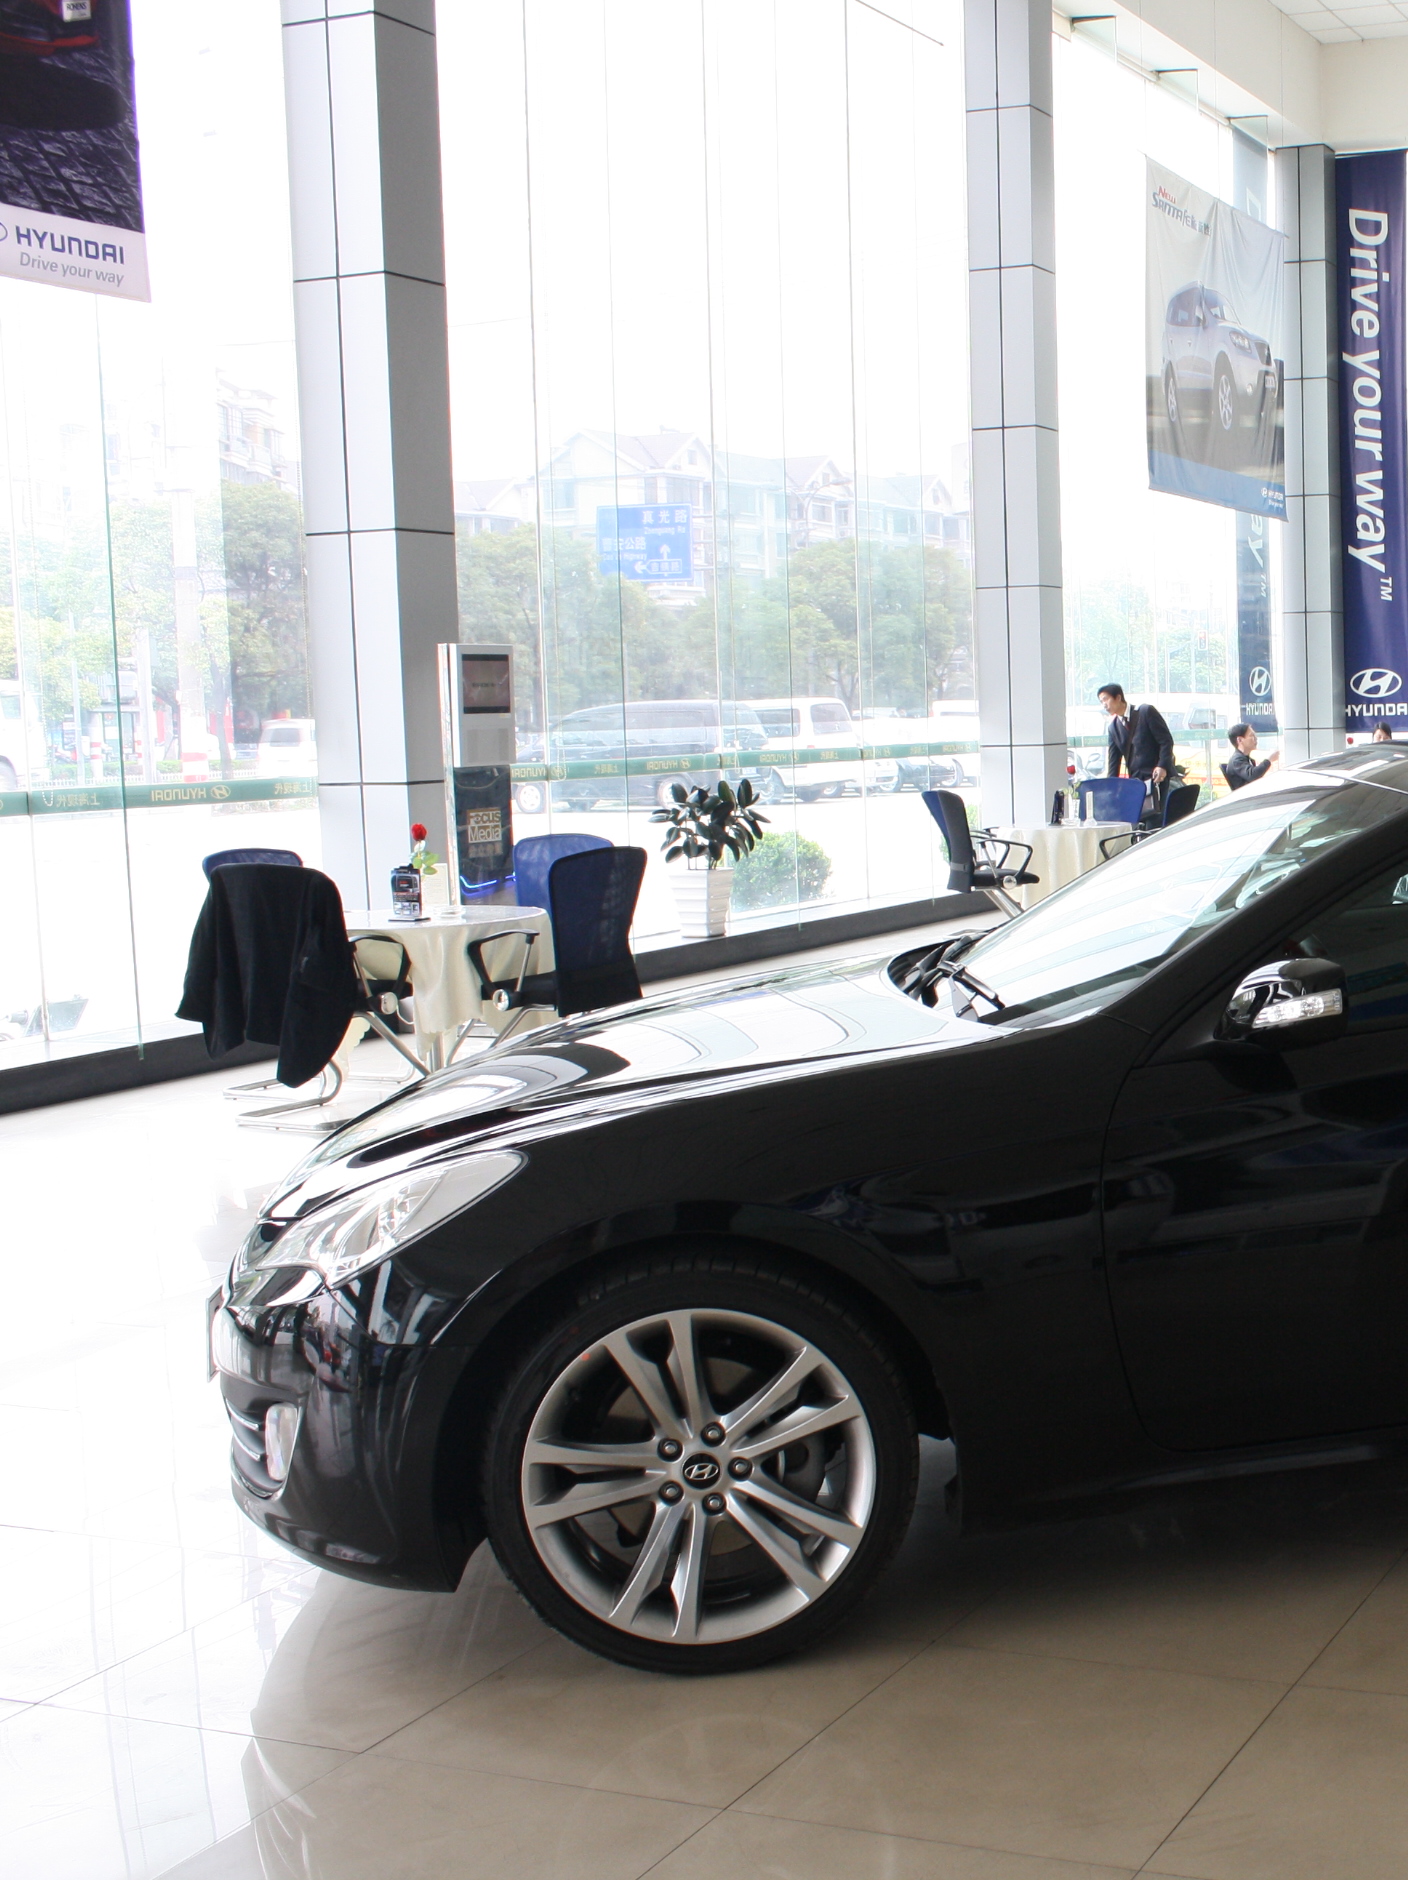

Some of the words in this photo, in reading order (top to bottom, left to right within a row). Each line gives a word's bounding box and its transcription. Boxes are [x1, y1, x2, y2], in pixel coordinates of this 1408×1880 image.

[15, 225, 125, 265] HYUNDAI
[20, 251, 59, 273] Drive
[60, 261, 93, 279] your
[94, 270, 125, 288] way
[1348, 208, 1390, 339] Drive
[1342, 350, 1383, 462] your
[1348, 470, 1386, 574] way
[469, 825, 502, 842] Media
